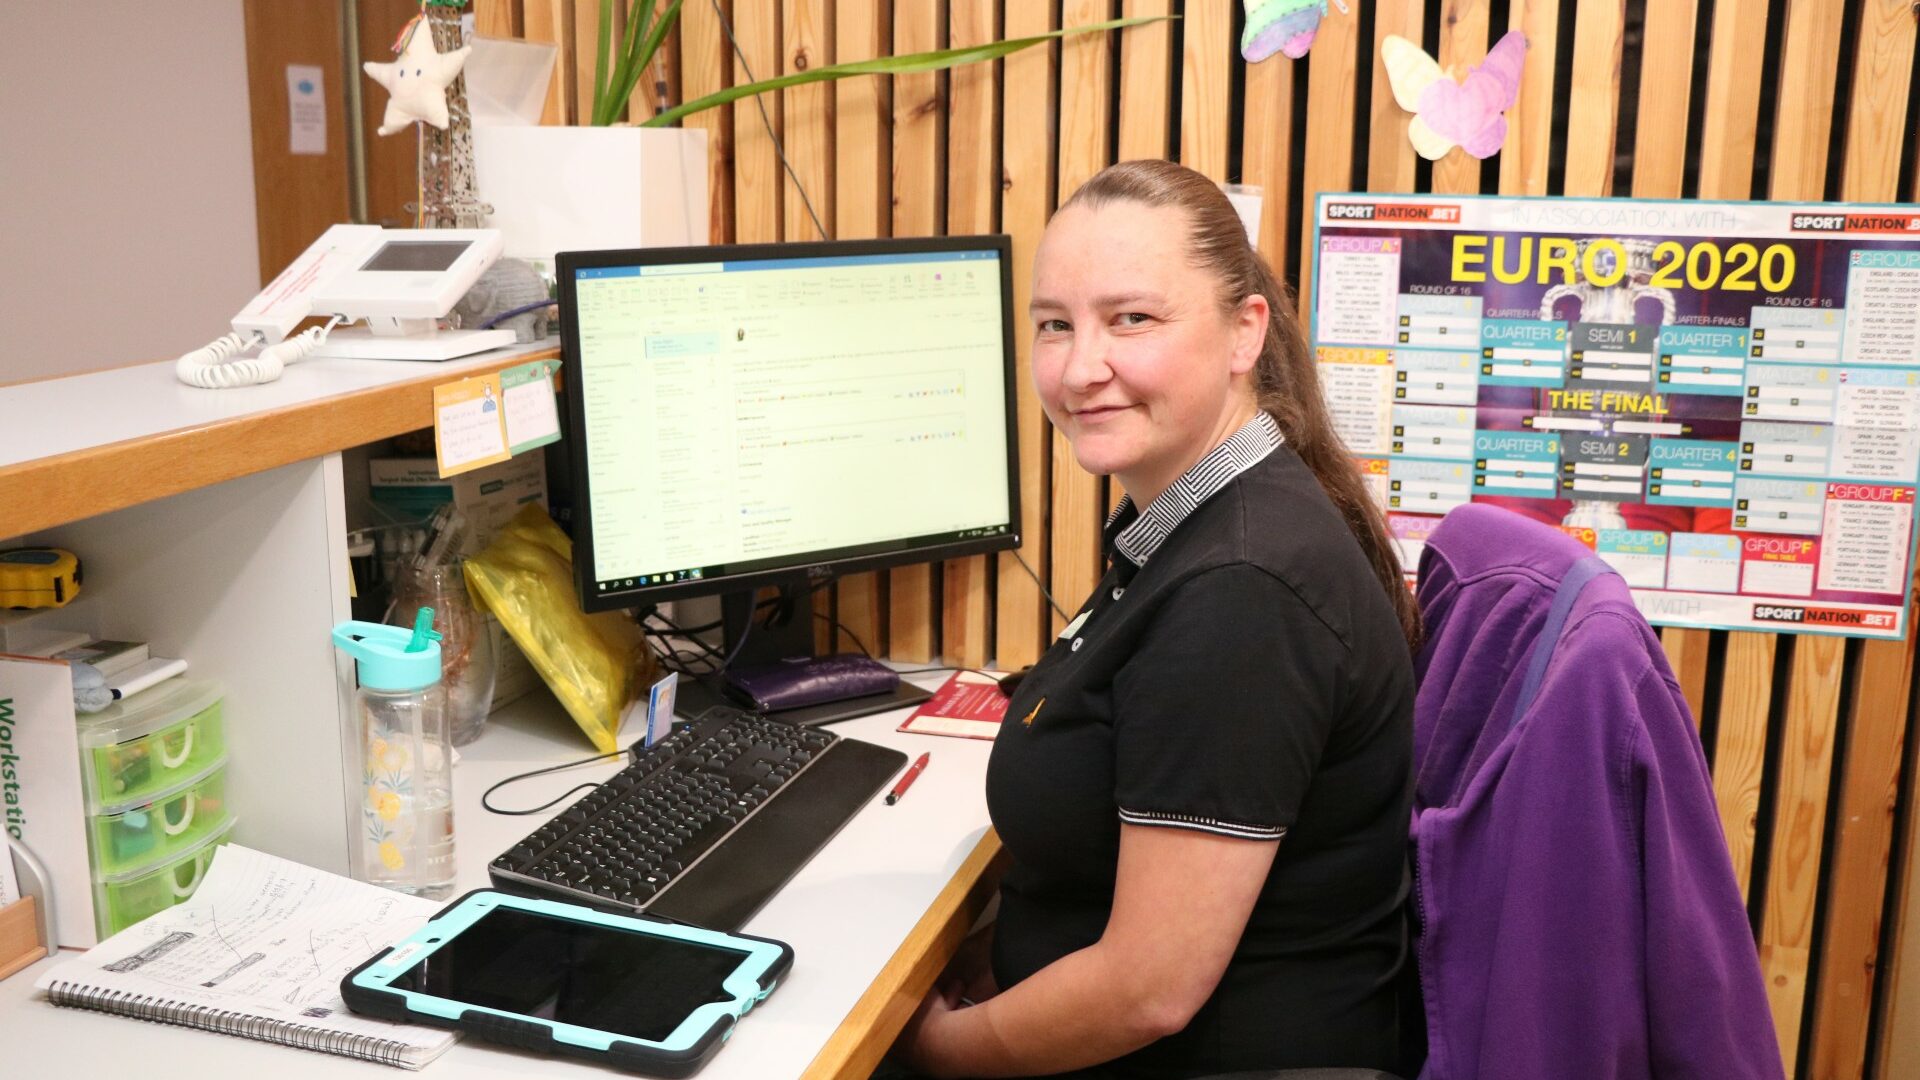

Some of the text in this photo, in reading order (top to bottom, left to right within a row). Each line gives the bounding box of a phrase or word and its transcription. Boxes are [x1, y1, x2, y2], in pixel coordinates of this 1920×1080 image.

[1328, 204, 1374, 218] SPORT
[1511, 207, 1736, 229] IN ASSOCIATION WITH
[1793, 216, 1845, 230] SPORT
[1450, 234, 1796, 293] EURO 2020
[1861, 252, 1920, 267] GROUP
[1410, 285, 1471, 296] ROUND OF 16
[1765, 297, 1833, 308] ROUND OF 16
[1483, 325, 1565, 342] QUARTER 2
[1588, 329, 1637, 344] SEMI 1
[1661, 332, 1746, 348] QUARTER 1
[1549, 390, 1669, 414] THE FINAL
[1476, 436, 1557, 453] QUARTER 3
[1580, 441, 1629, 457] SEMI 2
[1652, 446, 1736, 462] QUARTER 4
[1762, 552, 1796, 562] FINAL TABLE
[1654, 597, 1702, 616] WITH
[1754, 605, 1803, 621] SPORT
[0, 698, 26, 841] Workstatio
